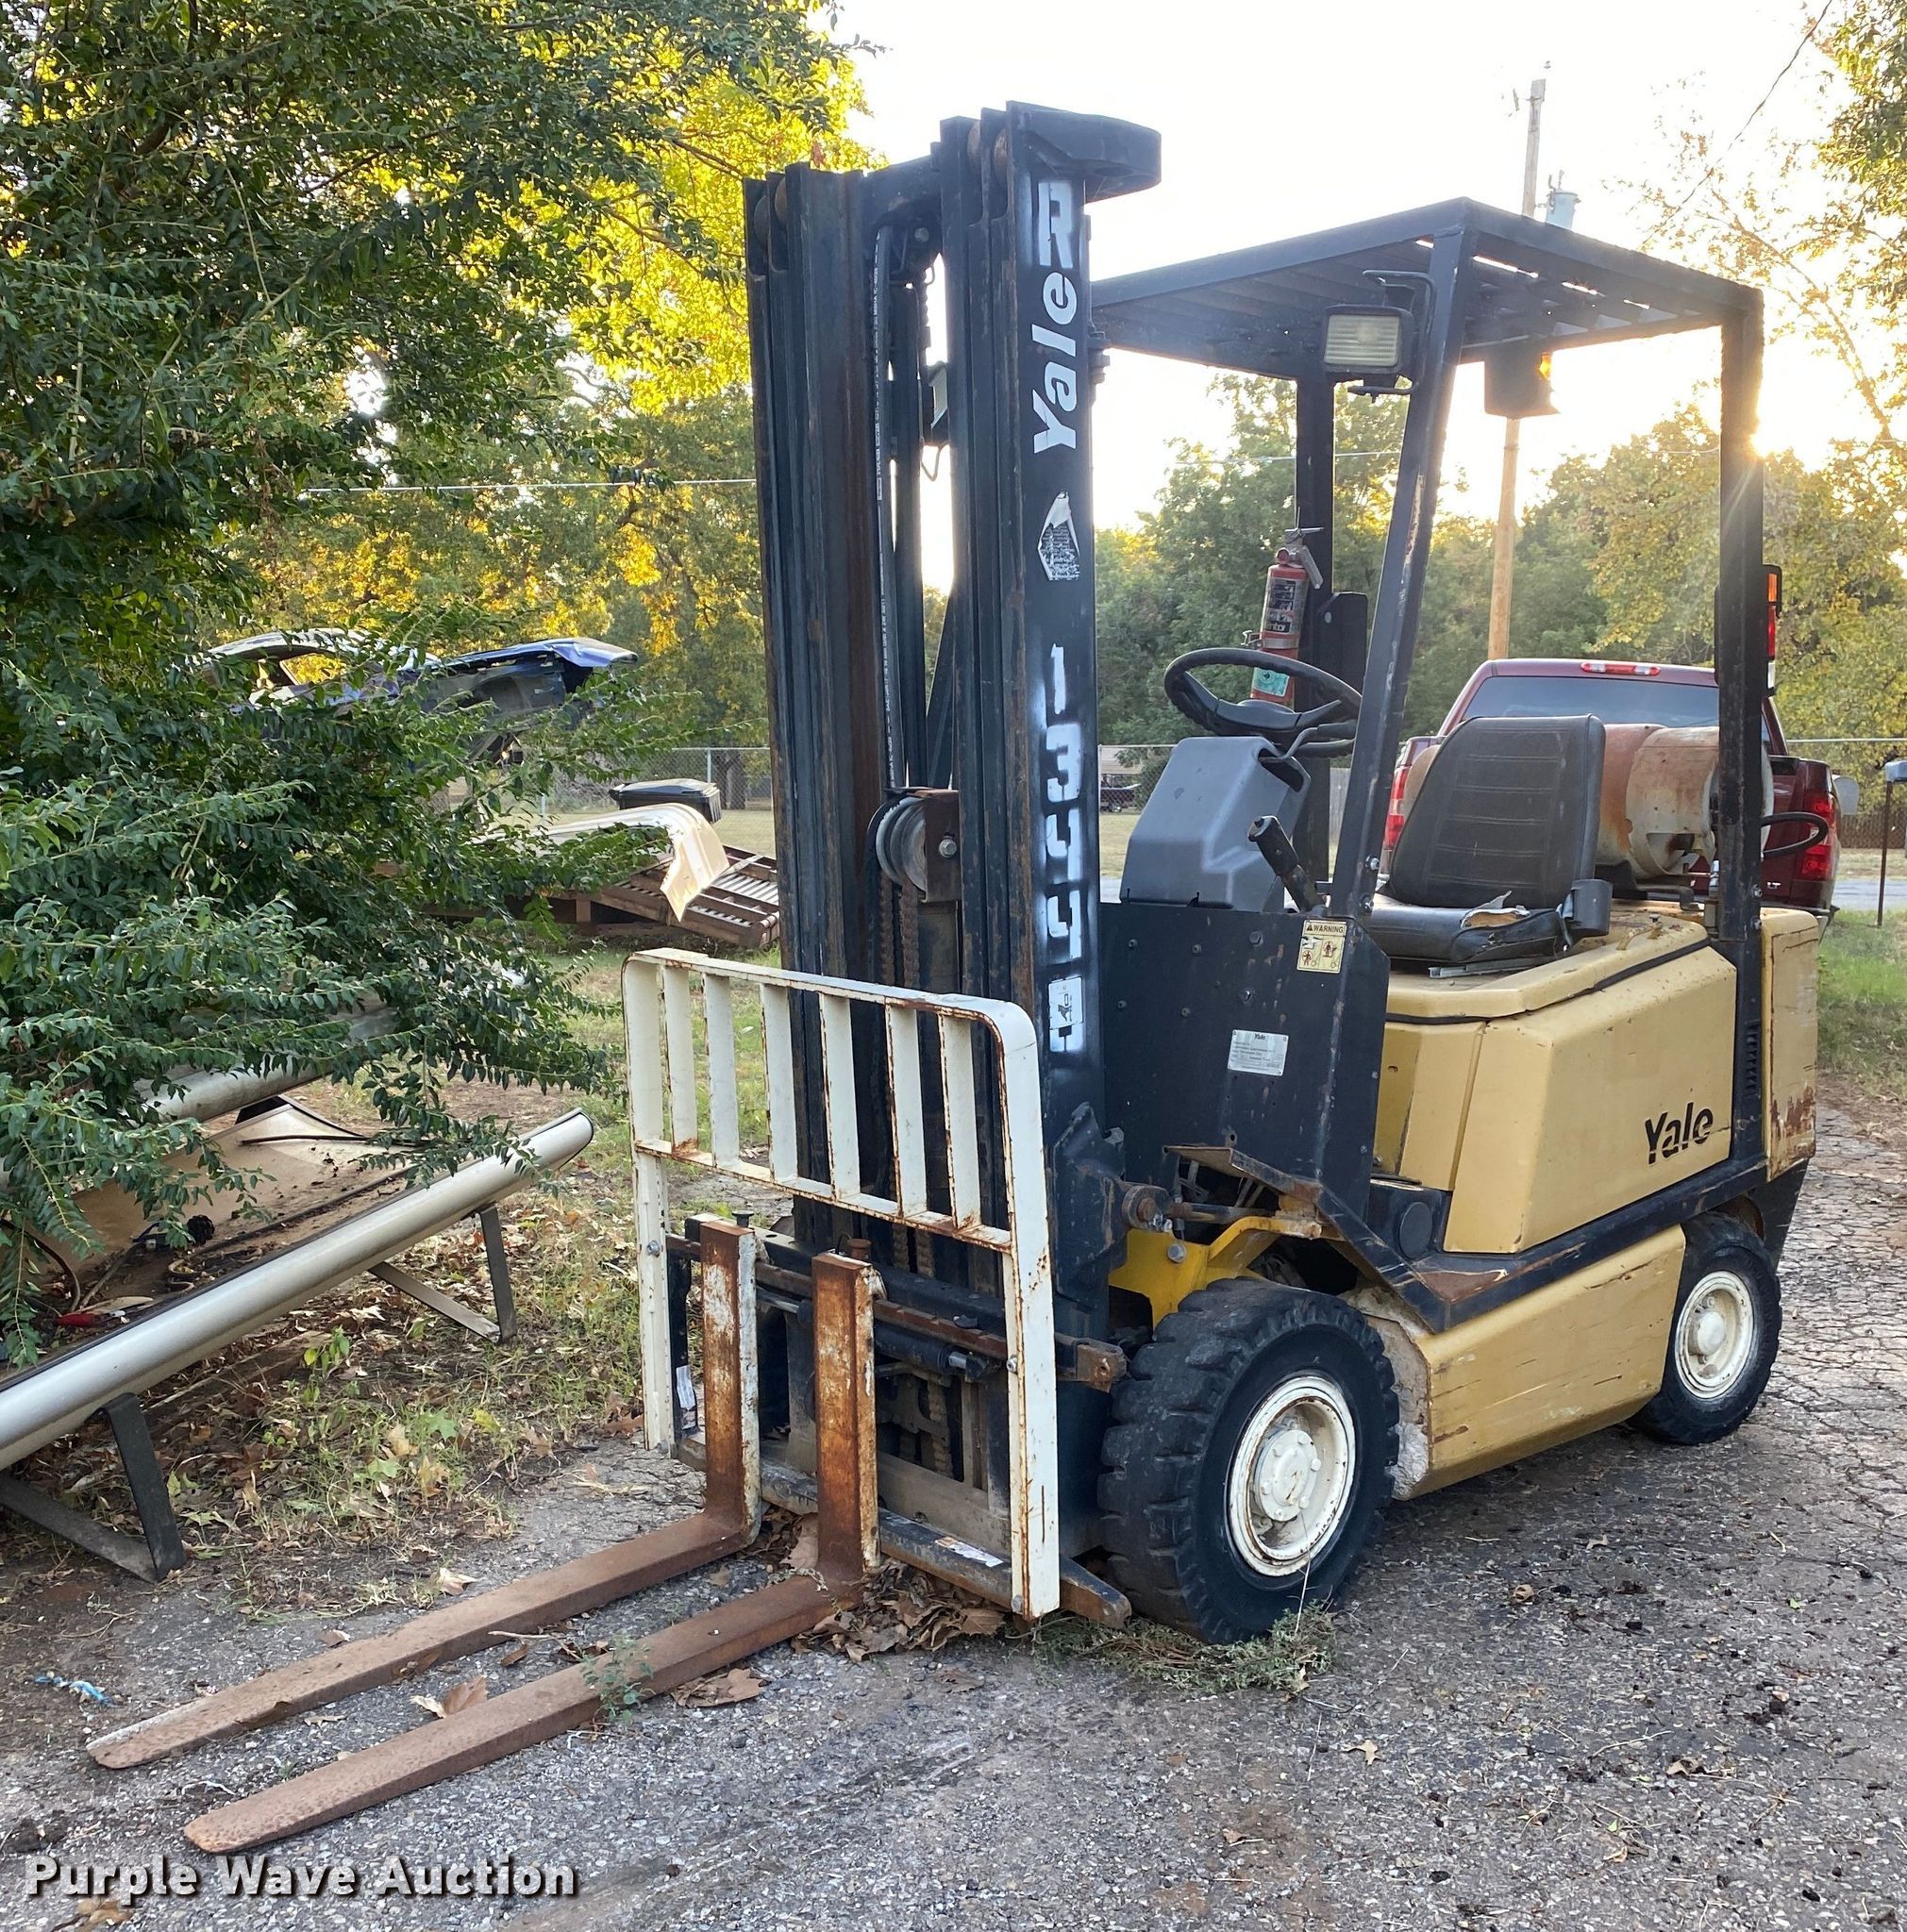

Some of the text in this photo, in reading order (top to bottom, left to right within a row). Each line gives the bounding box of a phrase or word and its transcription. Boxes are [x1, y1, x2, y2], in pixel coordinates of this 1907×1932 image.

[1031, 272, 1078, 455] Yale
[1313, 924, 1344, 934] WARNING
[1644, 1102, 1714, 1165] Yale
